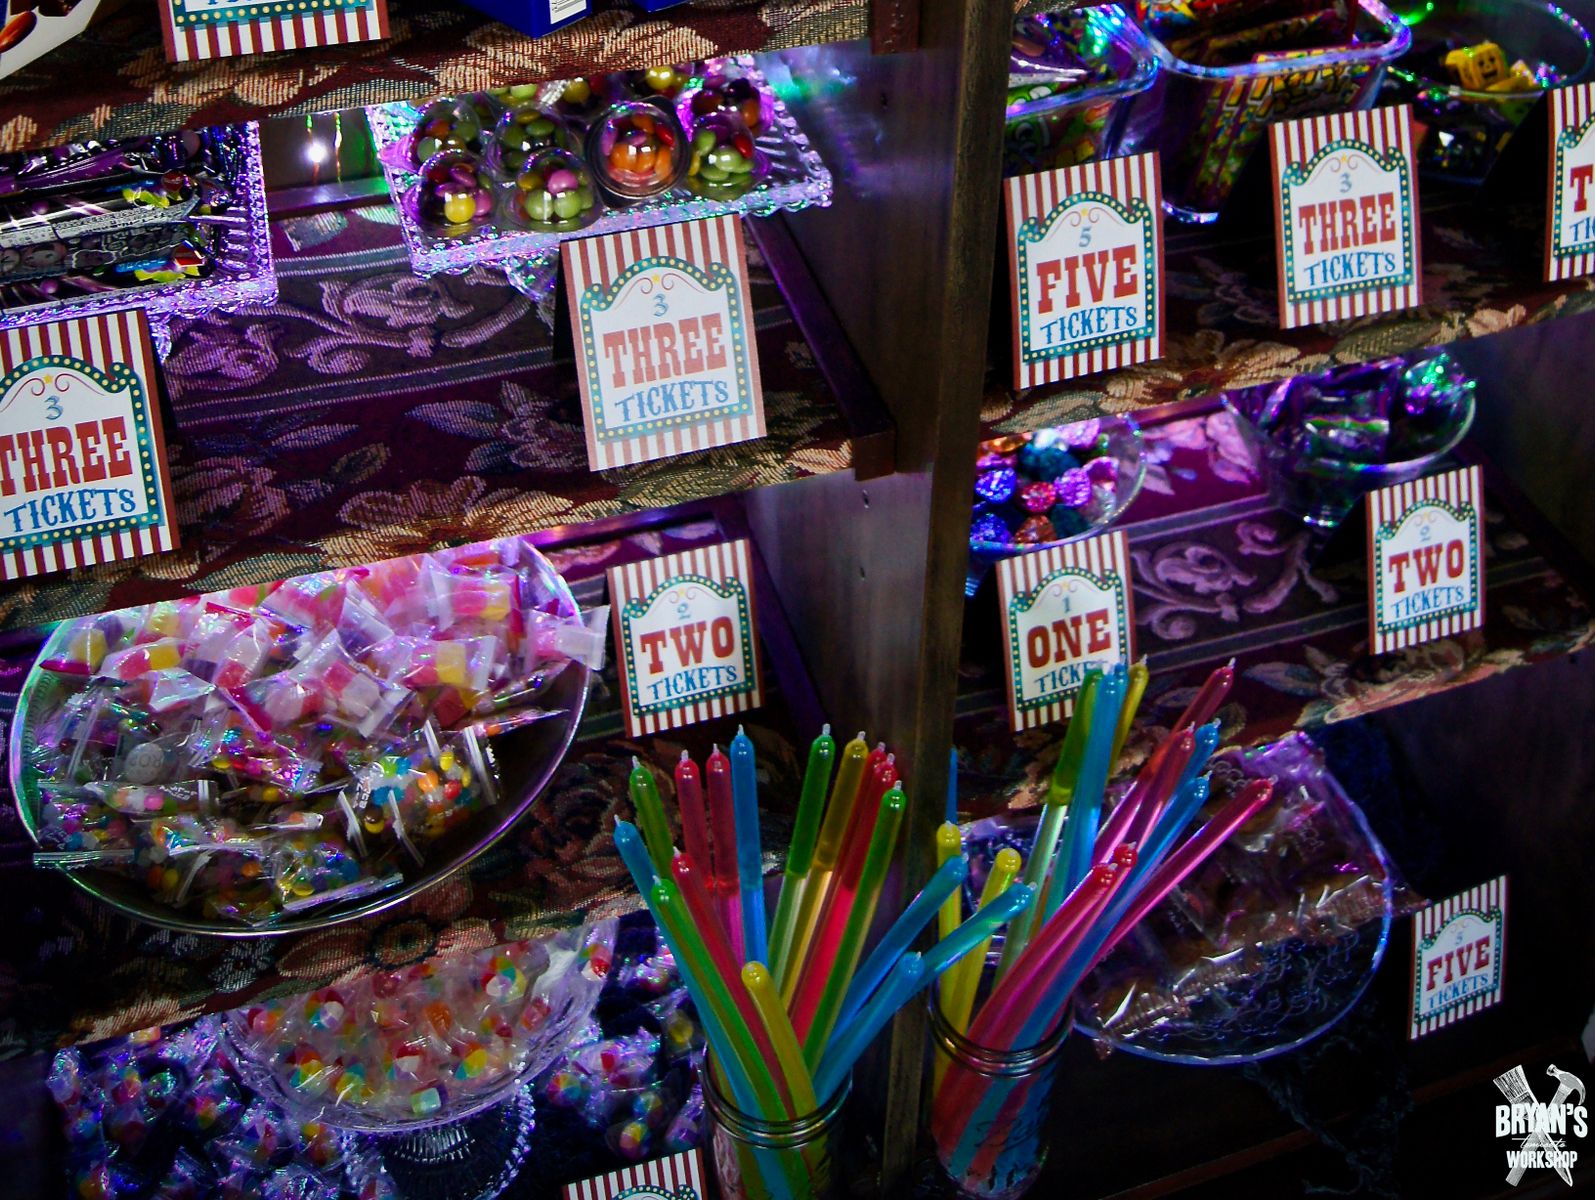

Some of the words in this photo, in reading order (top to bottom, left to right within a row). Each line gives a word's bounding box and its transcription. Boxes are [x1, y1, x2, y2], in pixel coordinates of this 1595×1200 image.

[1340, 172, 1352, 193] 3
[1079, 226, 1092, 248] 5
[1298, 192, 1396, 255] THREE
[1036, 244, 1138, 314] FIVE
[1304, 251, 1396, 286] TICKETS
[653, 293, 669, 317] 3
[1040, 306, 1138, 345] TICKETS
[603, 312, 727, 388] THREE
[45, 395, 63, 420] 3
[615, 379, 729, 422] TICKETS
[0, 415, 133, 497] THREE
[4, 488, 136, 532] TICKETS
[1420, 525, 1431, 542] 2
[1388, 539, 1465, 594] TWO
[677, 603, 691, 620] 2
[1062, 596, 1071, 614] 1
[1391, 586, 1465, 619] TICKETS
[640, 616, 735, 675] TWO
[1026, 608, 1112, 669] ONE
[648, 666, 738, 700] TICKETS
[1426, 935, 1491, 992] FIVE
[1427, 973, 1490, 1009] TICKETS
